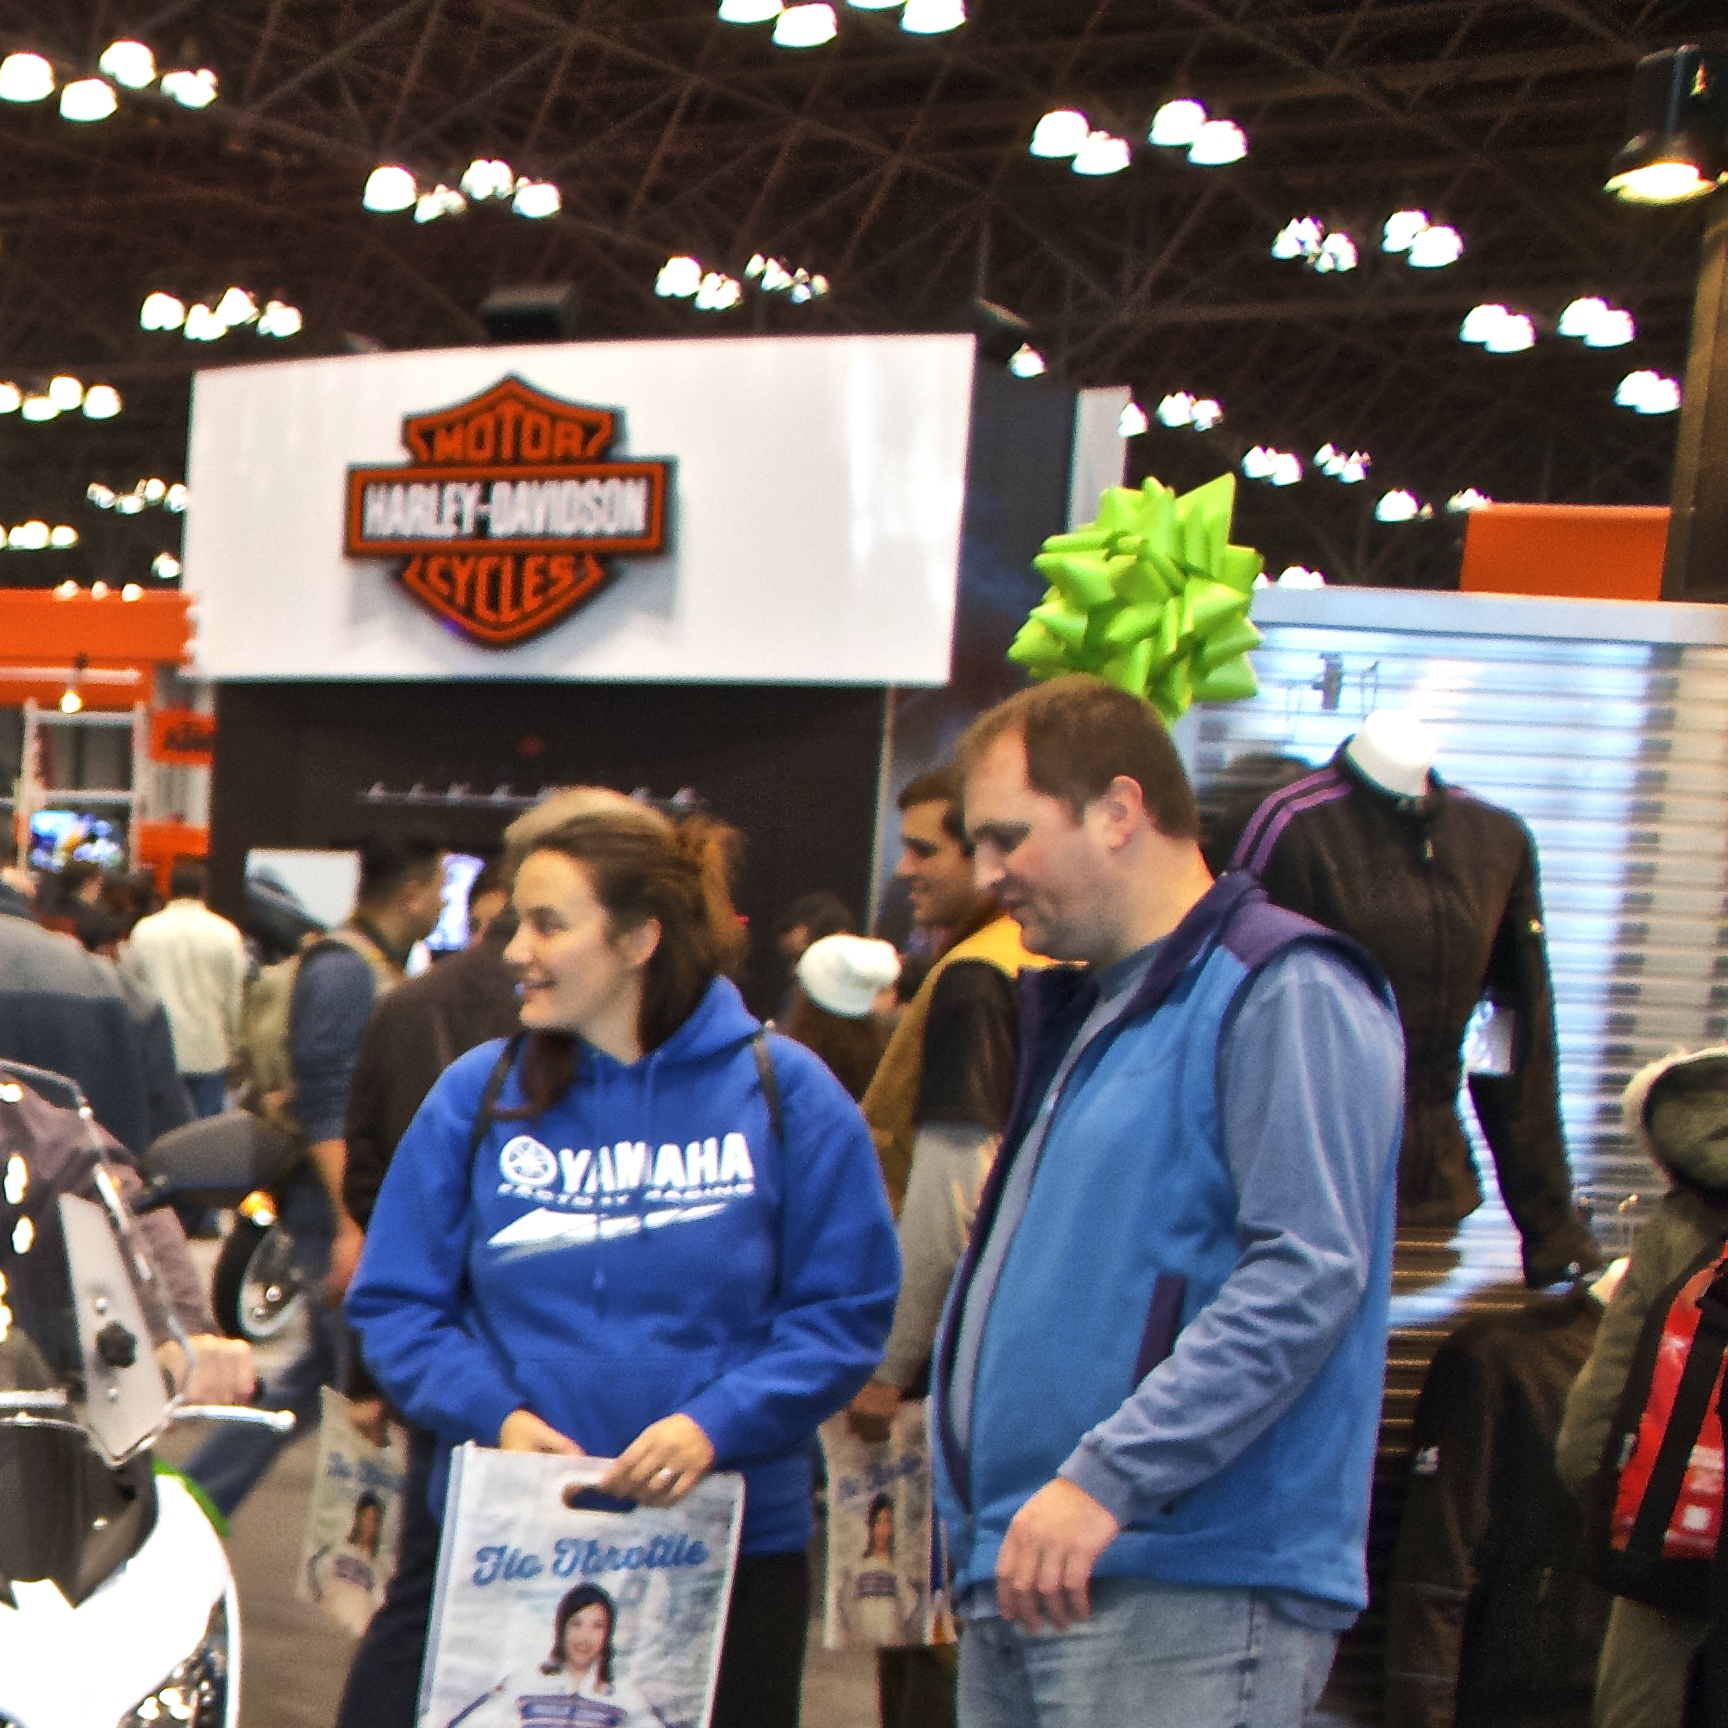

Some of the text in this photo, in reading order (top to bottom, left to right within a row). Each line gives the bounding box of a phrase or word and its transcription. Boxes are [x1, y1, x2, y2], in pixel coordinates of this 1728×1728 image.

[433, 403, 585, 462] MOTOR
[364, 478, 645, 538] HARLEY-DAVIDSON
[426, 555, 575, 621] CYCLES
[558, 1131, 754, 1194] YAMAHA
